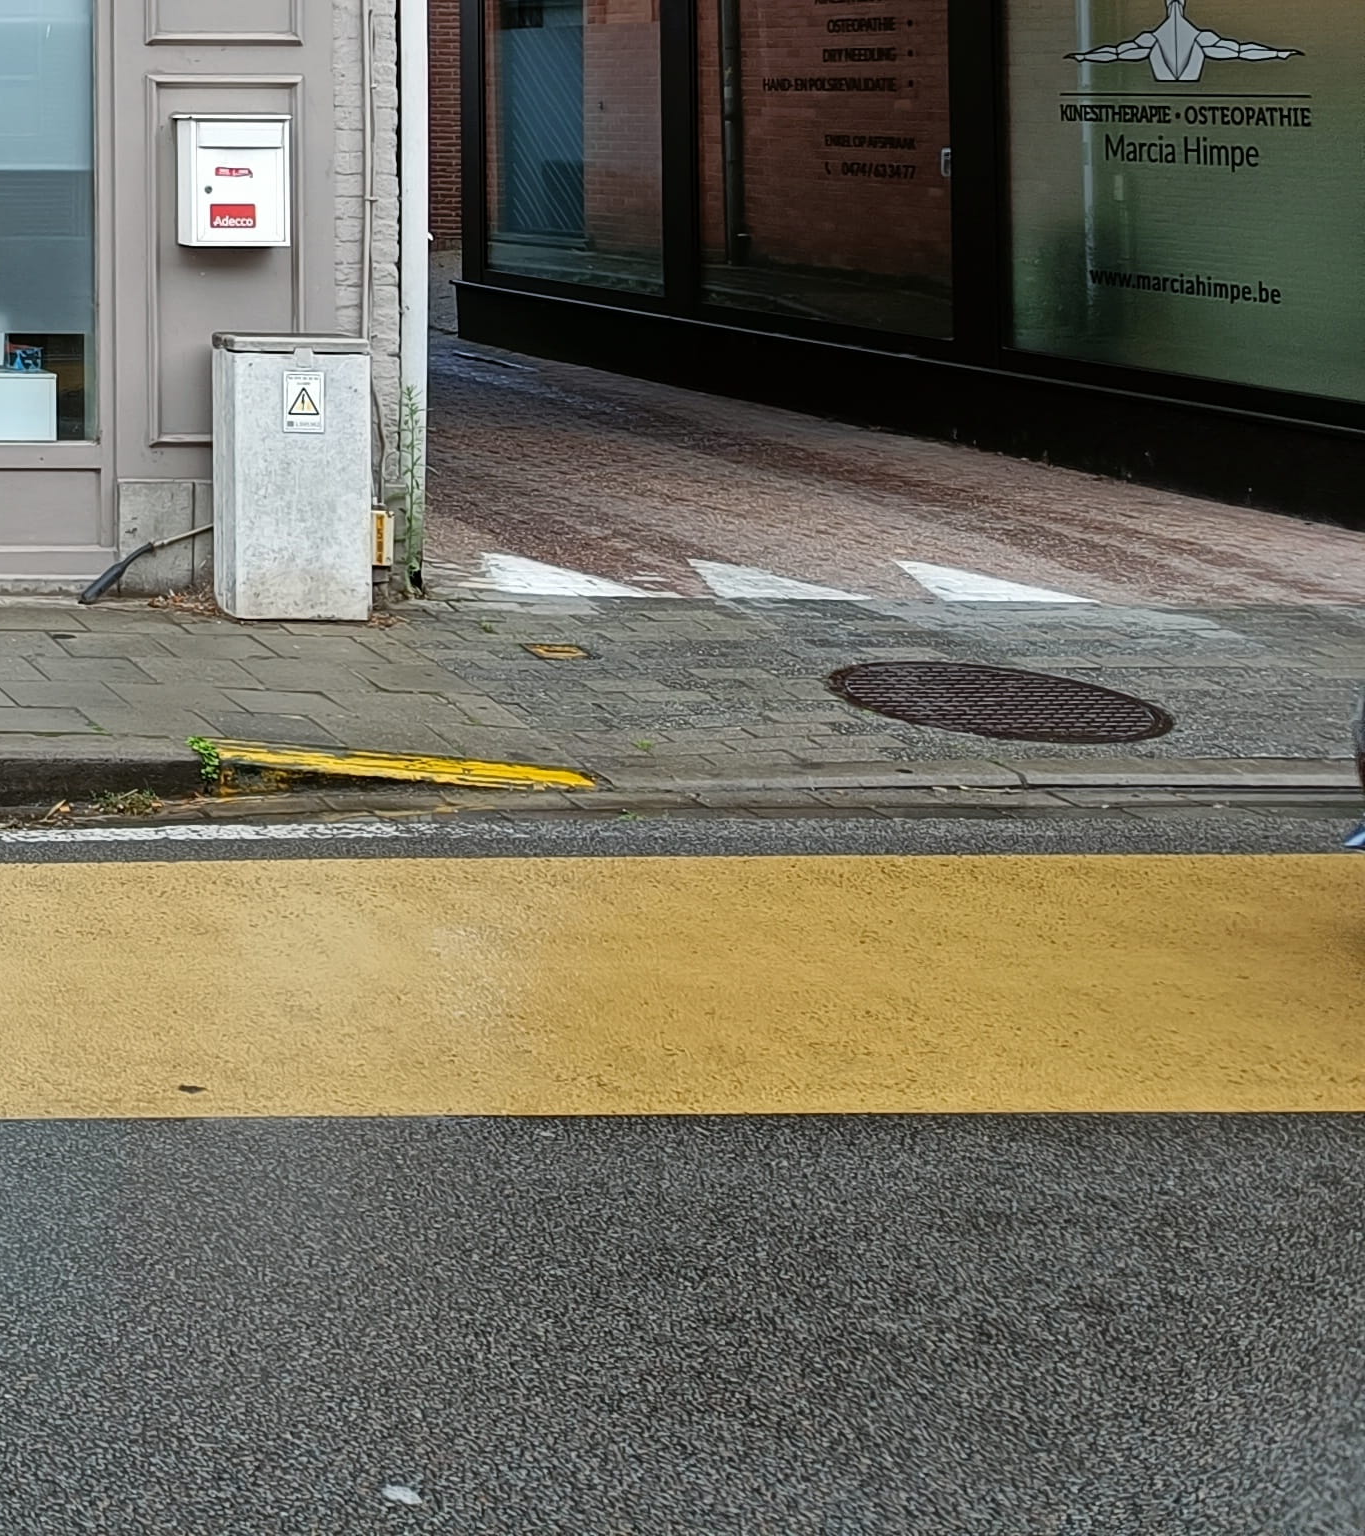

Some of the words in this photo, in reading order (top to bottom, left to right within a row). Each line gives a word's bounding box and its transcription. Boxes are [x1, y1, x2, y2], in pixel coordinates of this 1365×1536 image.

[827, 16, 897, 34] OSTEOPATHIE
[1060, 104, 1172, 123] KINESITHERAPIE
[1184, 106, 1312, 127] OSTEOPATHIE
[1105, 133, 1176, 163] Marcia
[1183, 136, 1260, 172] Himpe
[212, 215, 254, 227] Adecco
[1089, 268, 1282, 304] www.marciahimpe.be
